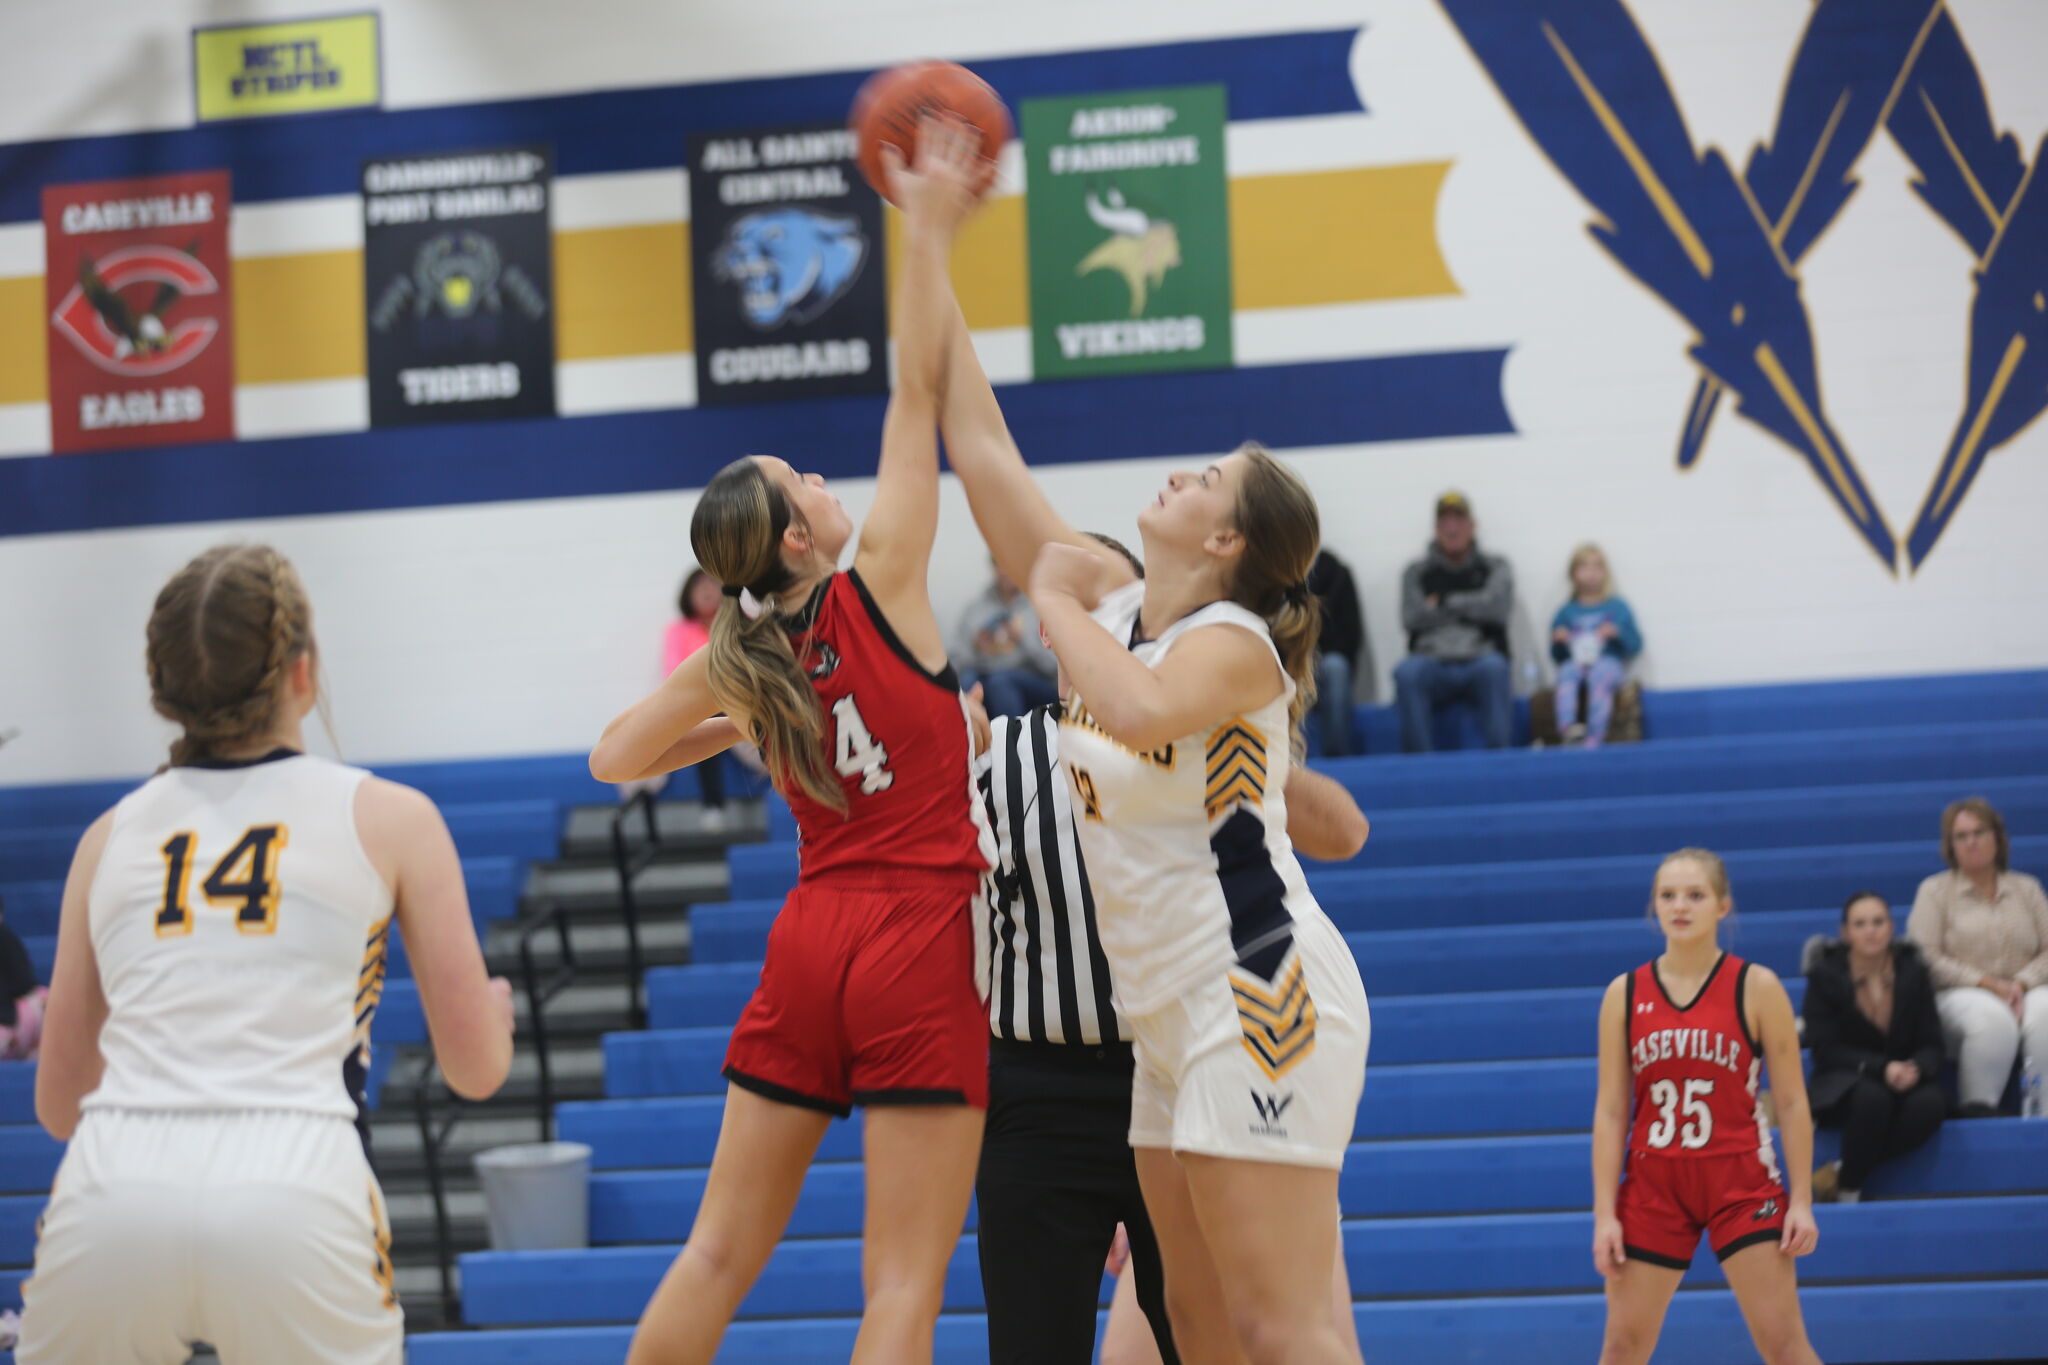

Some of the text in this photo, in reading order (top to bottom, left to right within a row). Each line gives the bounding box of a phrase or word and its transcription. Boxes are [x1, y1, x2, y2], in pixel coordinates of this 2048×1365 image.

[701, 137, 760, 172] ALL
[718, 165, 850, 206] CENTRAL
[62, 192, 214, 236] CASEVILLE
[1056, 316, 1205, 359] VIKINGS
[398, 362, 521, 405] TIGERS
[710, 340, 870, 384] COUGARS
[80, 385, 204, 430] EAGLES
[832, 692, 894, 795] 4
[154, 822, 288, 937] 14
[1647, 1078, 1715, 1149] 35
